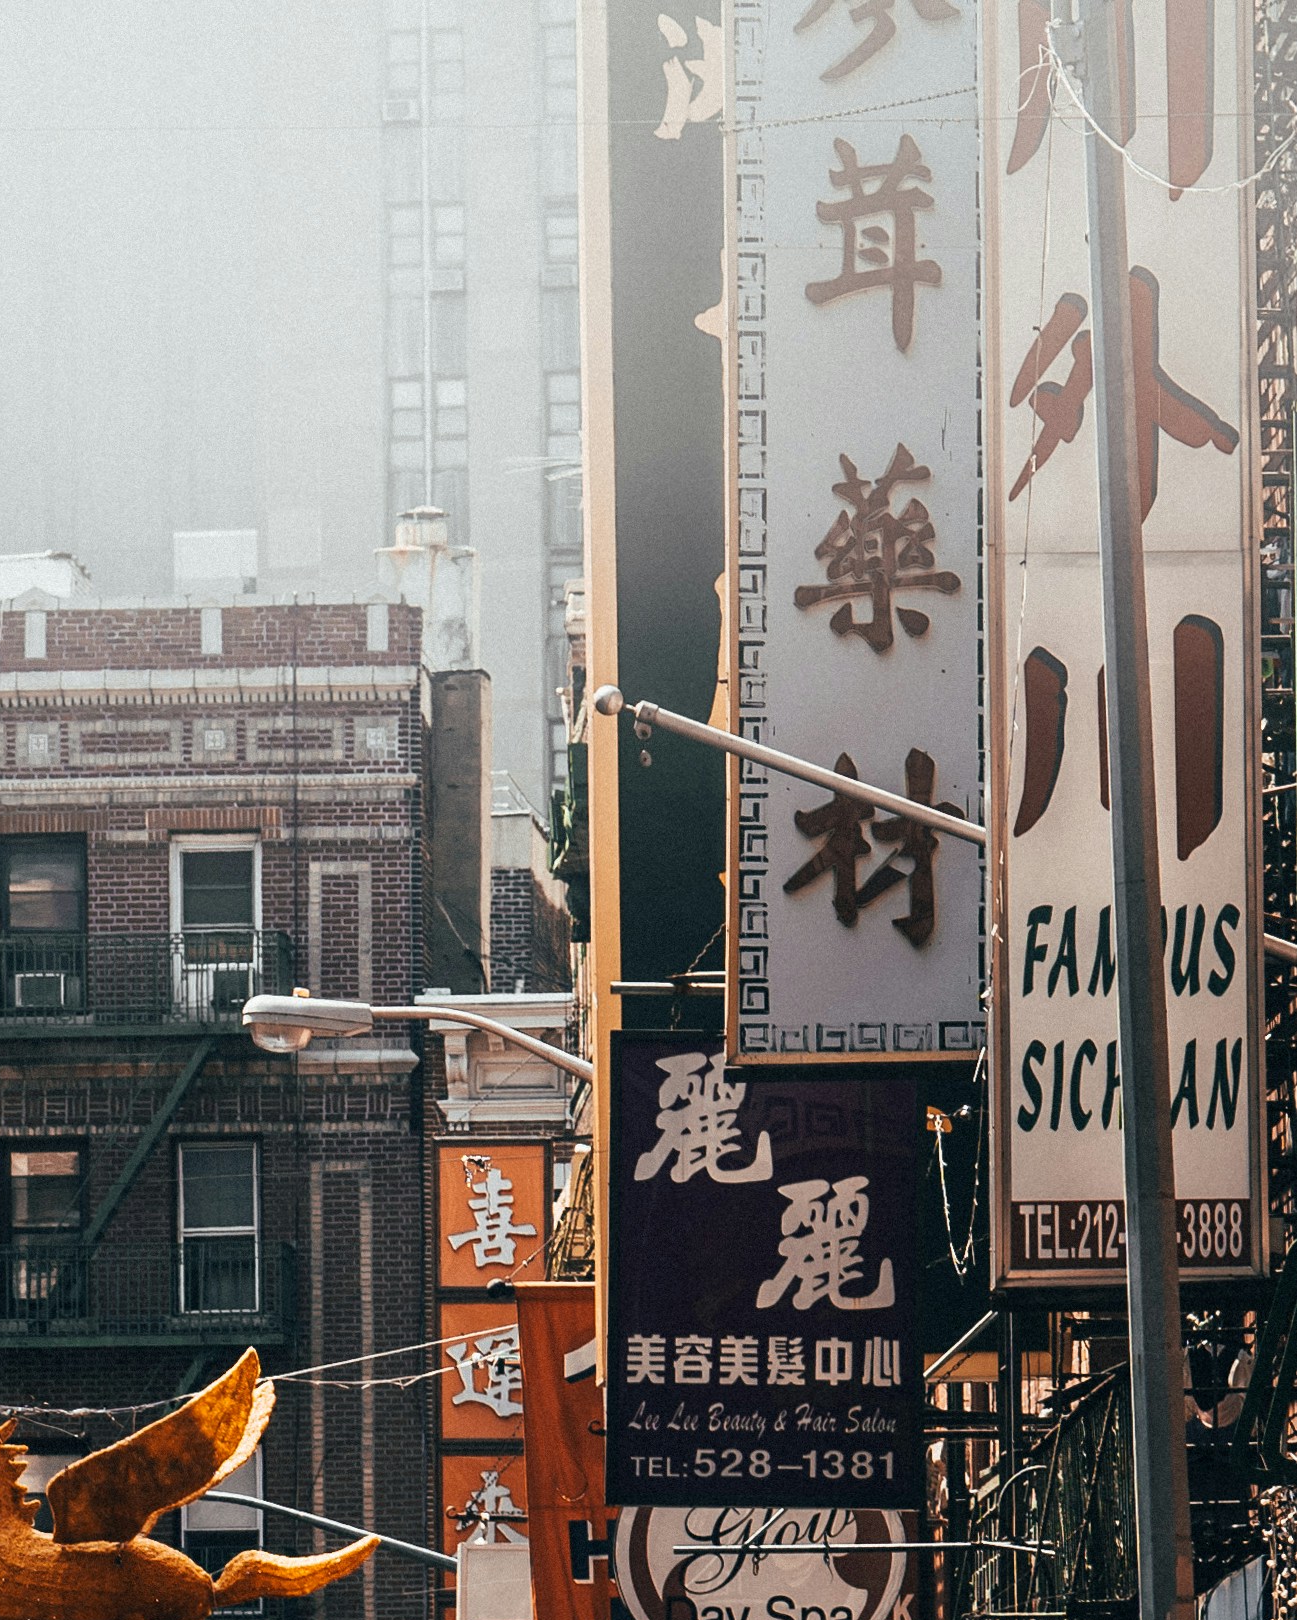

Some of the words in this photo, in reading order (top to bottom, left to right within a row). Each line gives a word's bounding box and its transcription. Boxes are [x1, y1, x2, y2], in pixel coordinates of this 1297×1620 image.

[1016, 1037, 1243, 1132] SICHAN
[627, 1333, 901, 1387] 美容美髮中心
[628, 1401, 660, 1431] Lee
[667, 1401, 699, 1431] Lee
[708, 1402, 767, 1440] Beauty
[773, 1409, 787, 1433] &
[795, 1403, 837, 1433] Hair
[845, 1405, 898, 1434] Salon
